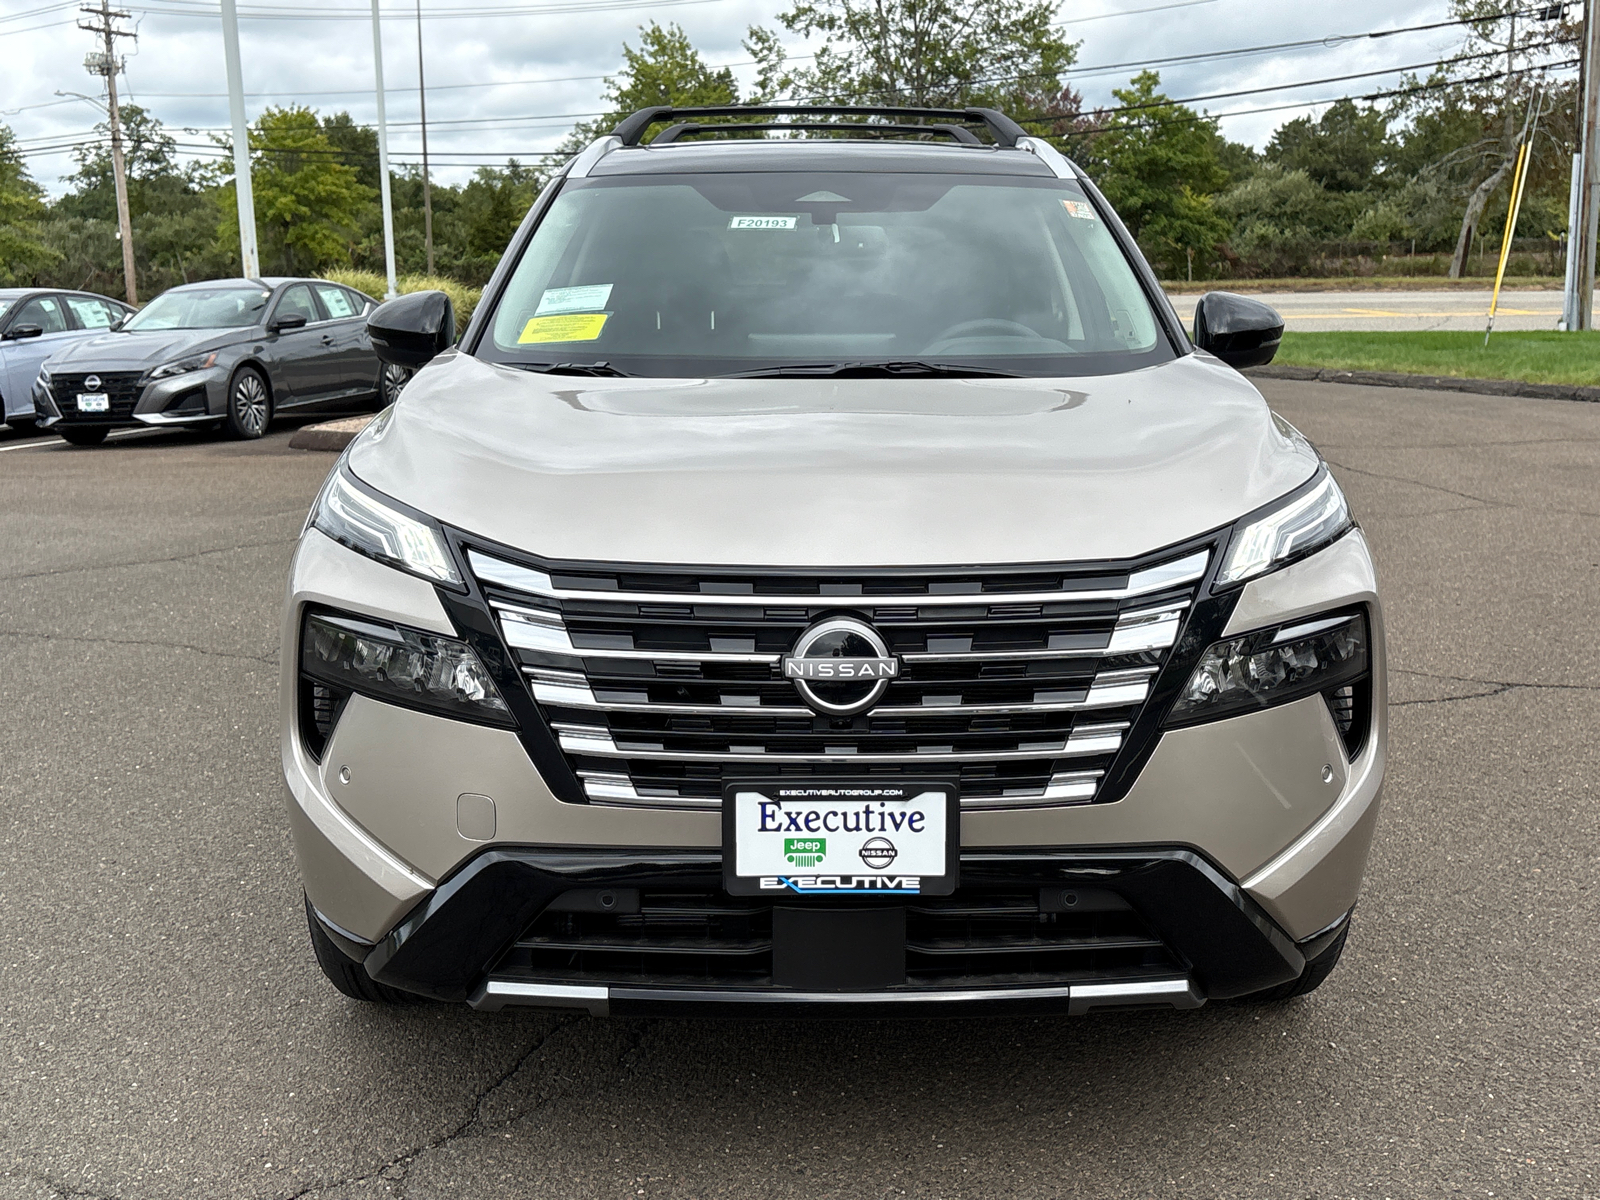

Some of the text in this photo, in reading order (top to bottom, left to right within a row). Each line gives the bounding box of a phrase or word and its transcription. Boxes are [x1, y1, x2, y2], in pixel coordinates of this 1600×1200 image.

[737, 219, 788, 228] F20193
[787, 662, 896, 677] NISSAN
[757, 801, 926, 833] Executive
[789, 839, 821, 852] Jeep
[861, 849, 896, 857] NISSAN
[759, 876, 921, 890] EXECUTIVE
